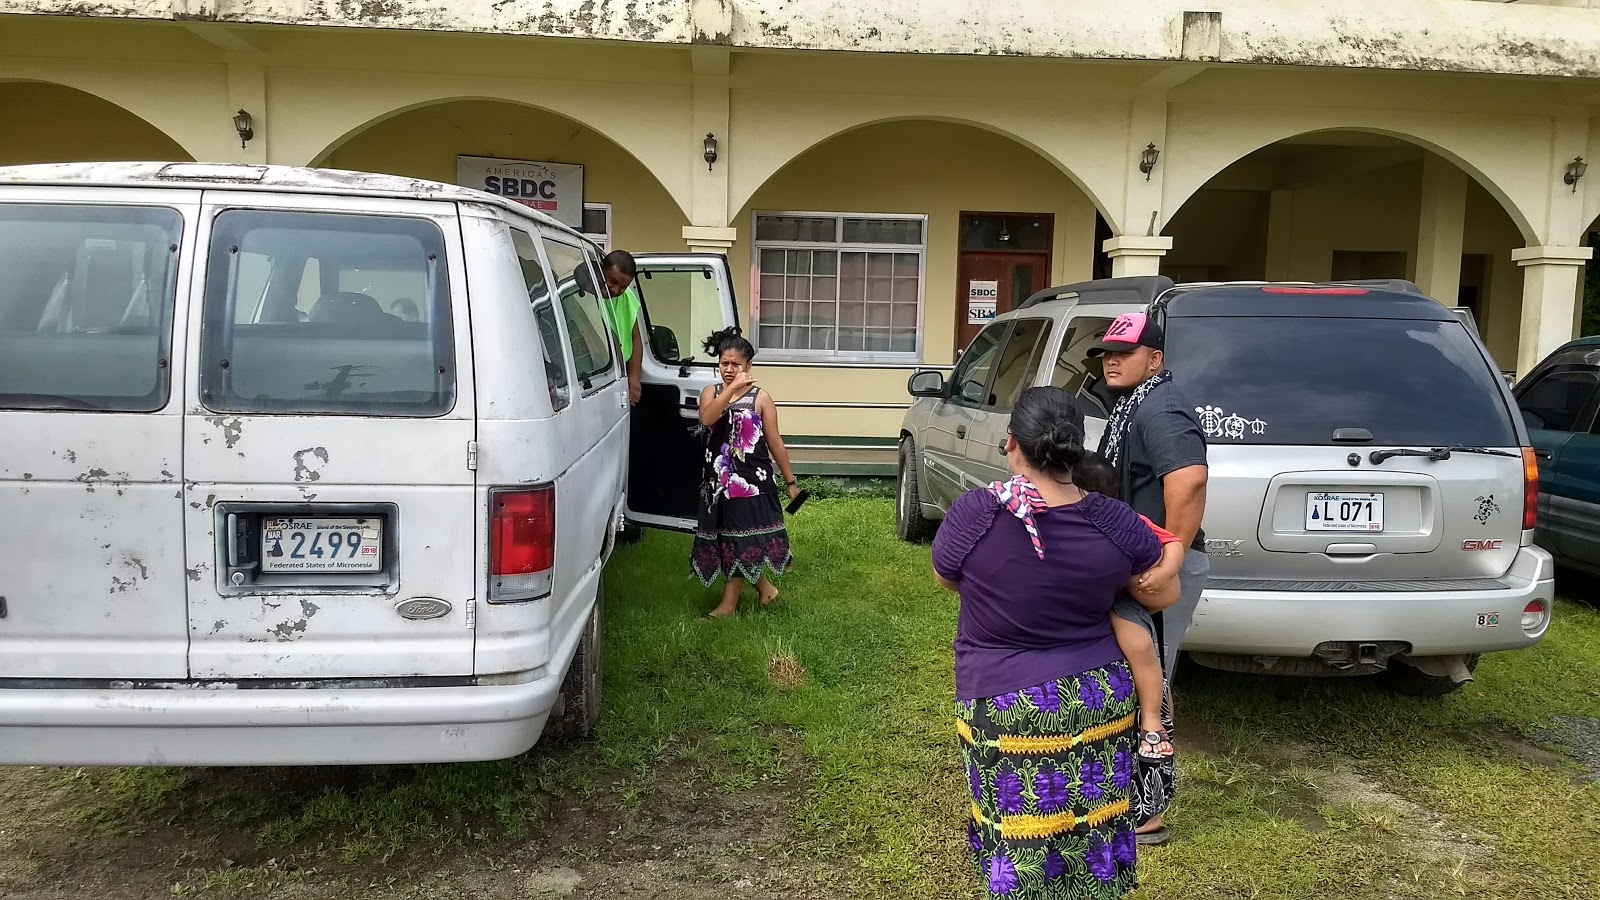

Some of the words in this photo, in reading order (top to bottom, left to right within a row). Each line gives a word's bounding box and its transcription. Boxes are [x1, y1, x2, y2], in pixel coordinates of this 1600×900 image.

[485, 167, 556, 179] AMERICA'S
[484, 176, 557, 199] SBDC
[969, 309, 996, 318] SBA
[1324, 502, 1334, 521] L
[1340, 502, 1372, 522] 071
[279, 522, 313, 530] OSRAE
[290, 531, 362, 559] 2499
[1462, 539, 1503, 551] GMC
[407, 602, 437, 613] Ford
[1477, 615, 1486, 625] 8
